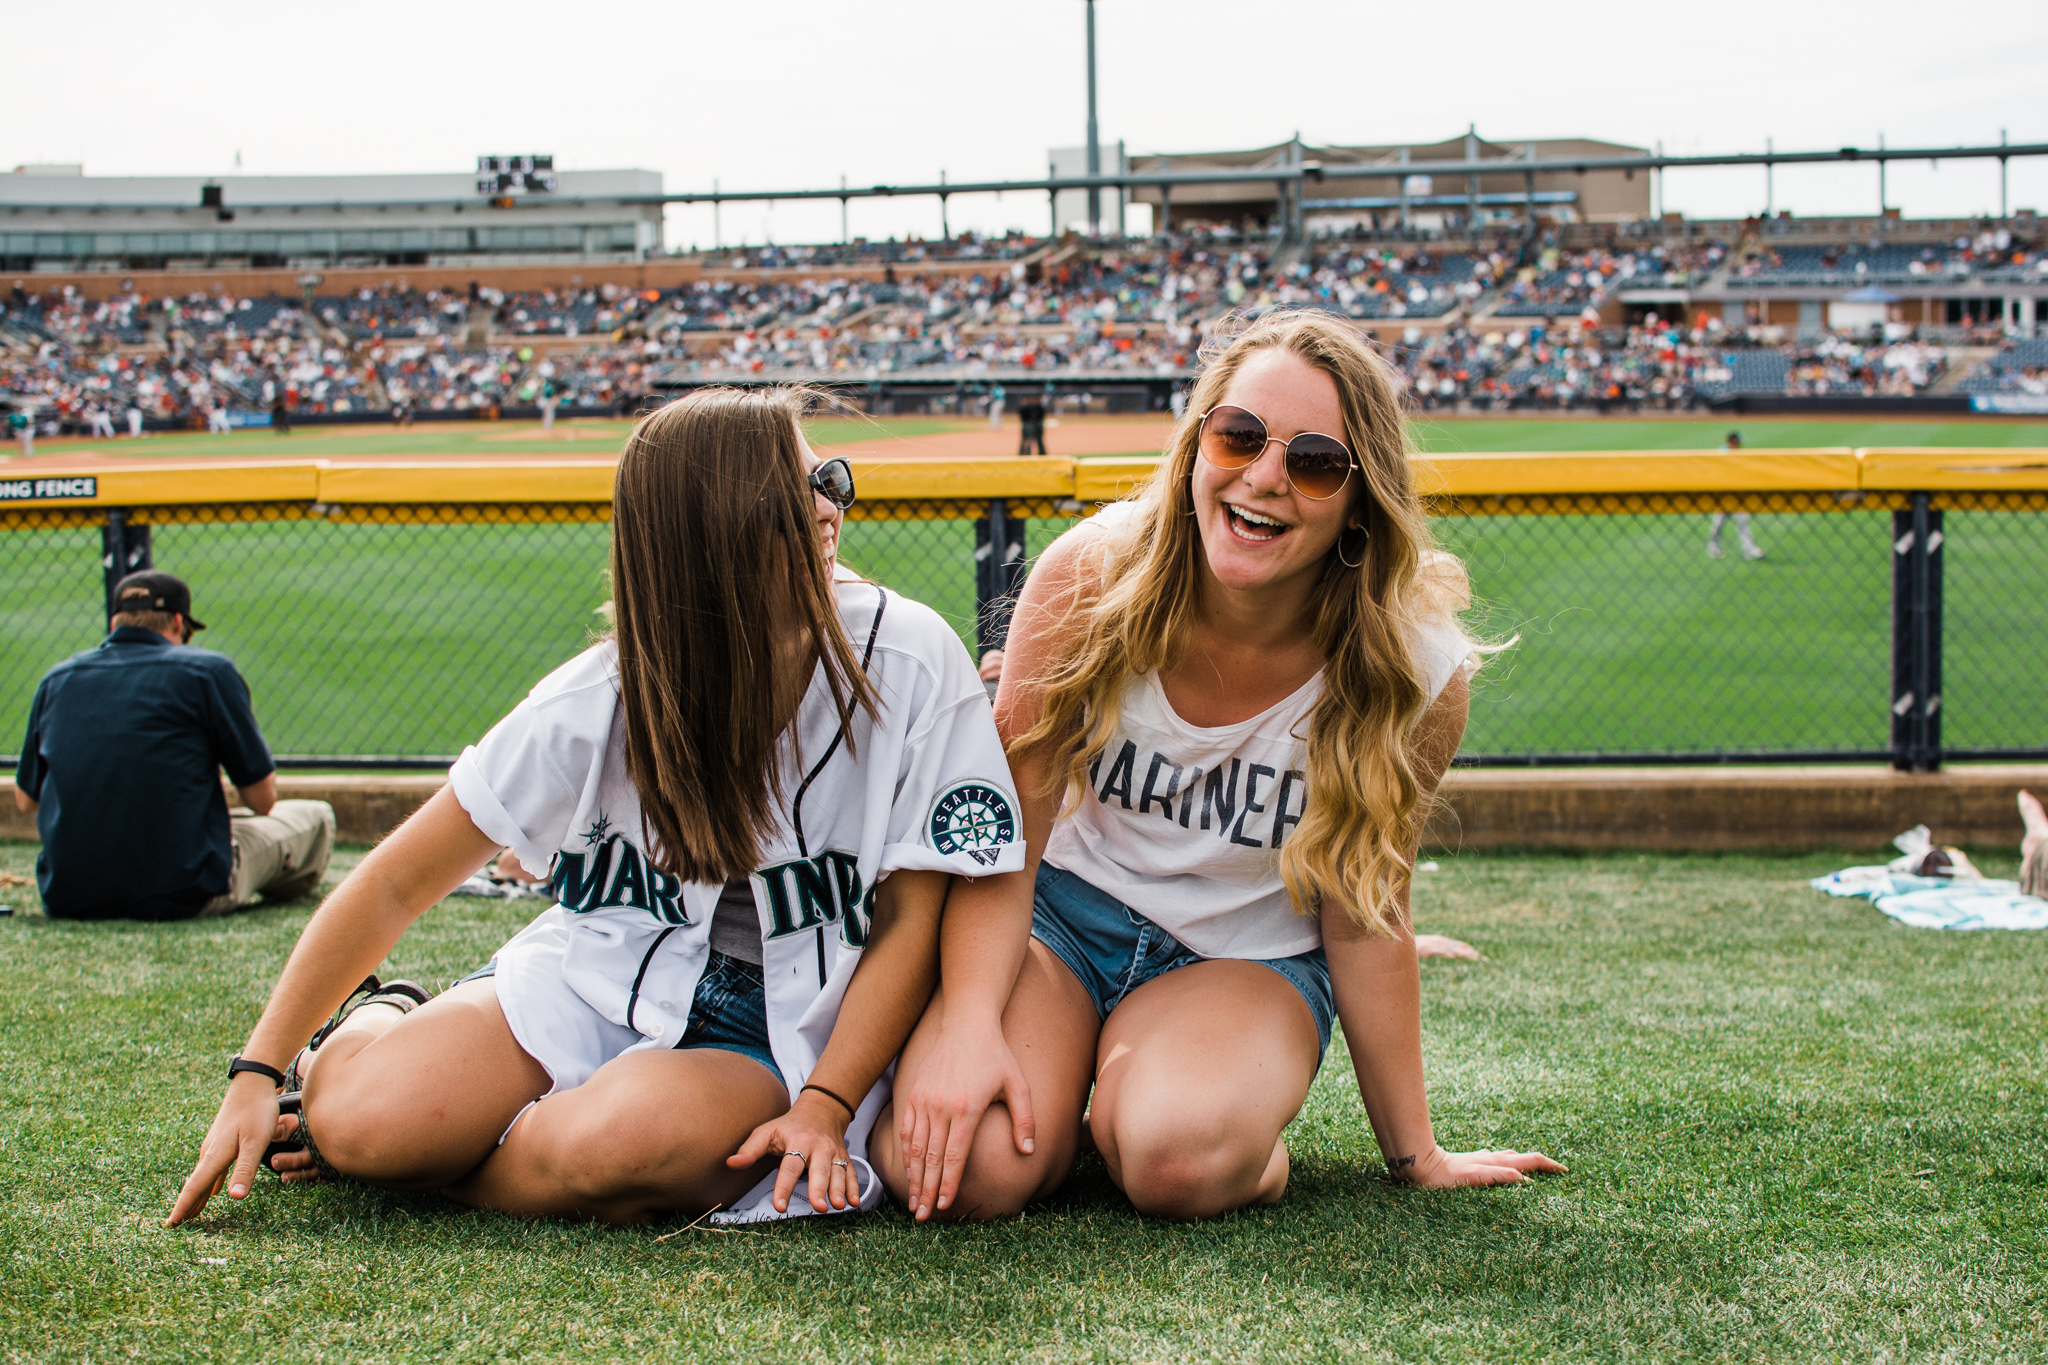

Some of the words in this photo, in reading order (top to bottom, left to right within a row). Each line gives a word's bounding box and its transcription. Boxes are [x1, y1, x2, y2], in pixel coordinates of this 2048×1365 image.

[0, 481, 32, 498] NG
[35, 478, 95, 497] FENCE
[935, 788, 1006, 823] SEATTLE
[552, 833, 691, 926] MAR
